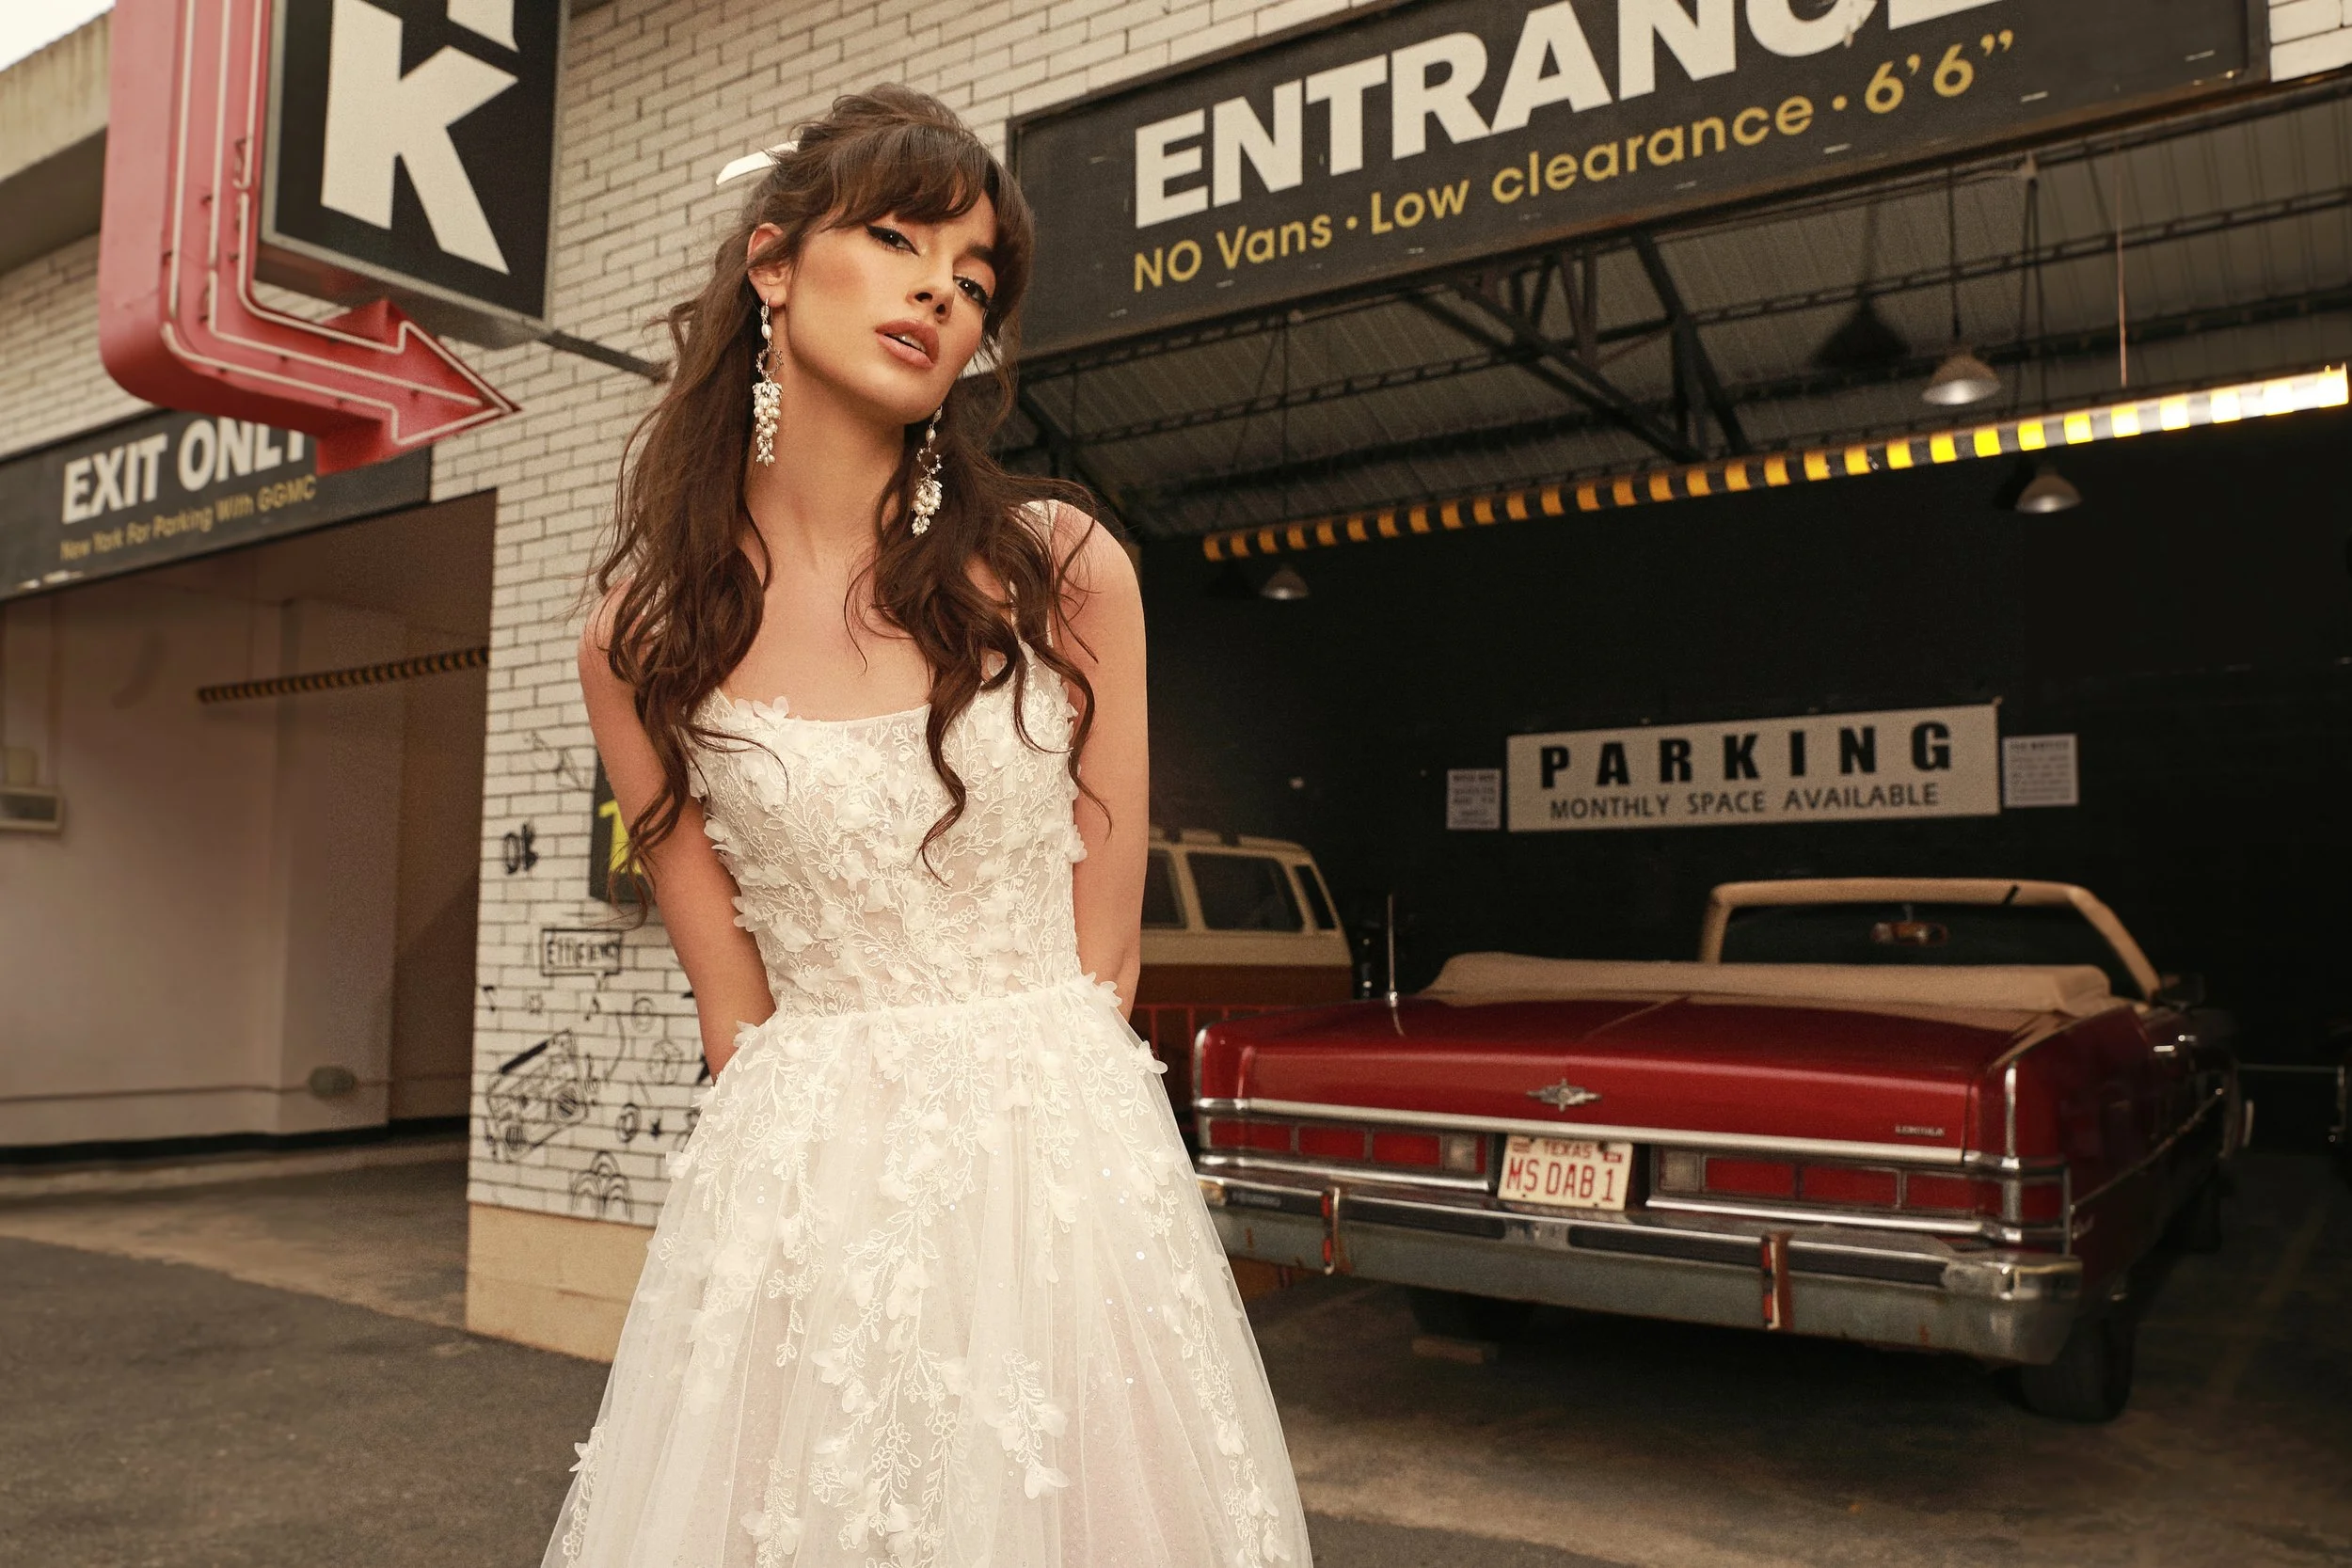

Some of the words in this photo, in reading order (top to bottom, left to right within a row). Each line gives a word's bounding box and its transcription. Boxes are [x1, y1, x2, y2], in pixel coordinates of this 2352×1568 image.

[1135, 0, 2002, 229] ENTRANC
[1134, 238, 1202, 292] NO
[1216, 213, 1332, 270] Vans
[1371, 179, 1470, 235] Low
[1490, 95, 1815, 204] clearance
[60, 539, 91, 562] New
[92, 531, 124, 551] York
[126, 522, 151, 545] For
[152, 506, 214, 538] Parking
[215, 494, 254, 524] With
[257, 475, 317, 513] GGMC
[61, 433, 168, 525] EXIT
[1540, 721, 1951, 789] PARKING
[1549, 793, 1669, 820] MONTHLY
[1686, 790, 1766, 816] SPACE
[1783, 782, 1939, 811] AVAILABLE
[1544, 1139, 1594, 1160] TEXAS
